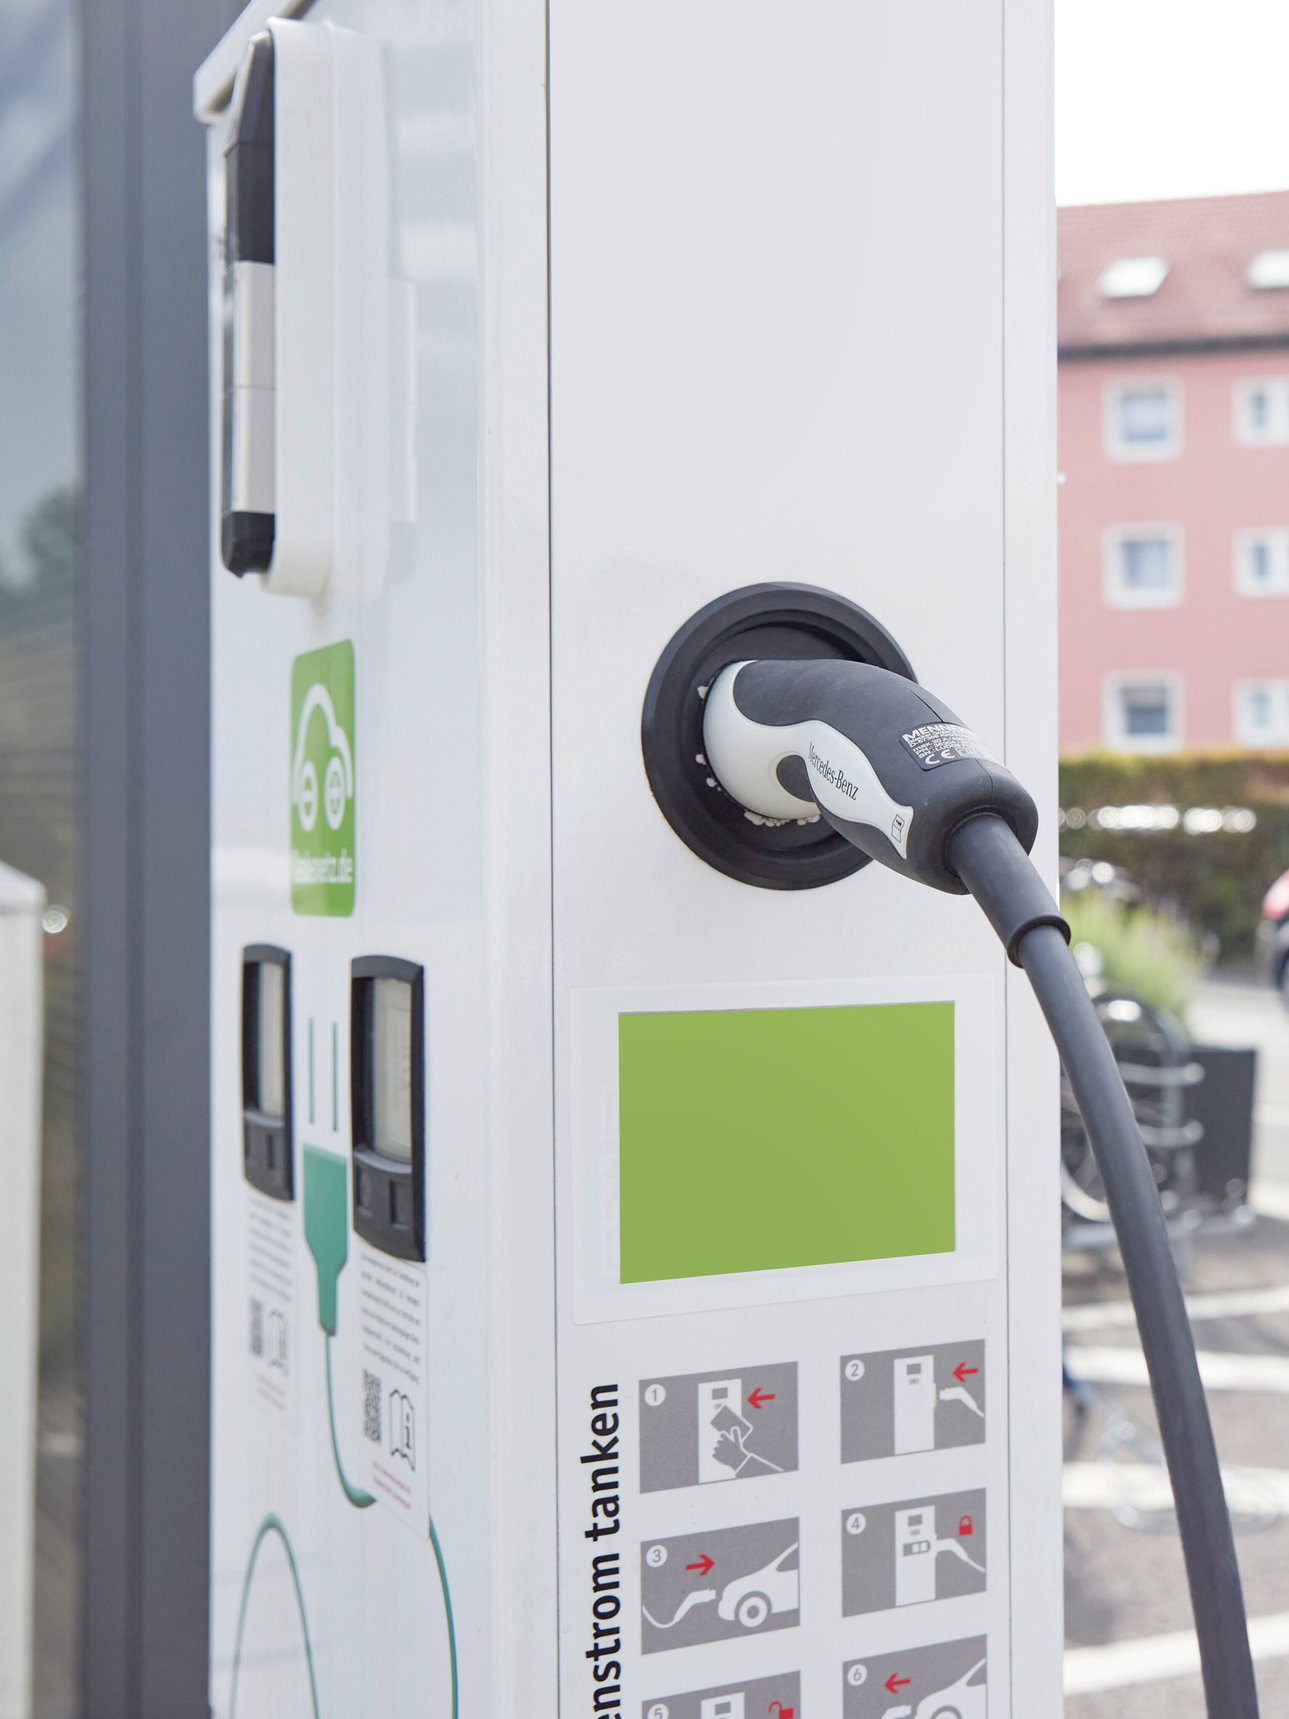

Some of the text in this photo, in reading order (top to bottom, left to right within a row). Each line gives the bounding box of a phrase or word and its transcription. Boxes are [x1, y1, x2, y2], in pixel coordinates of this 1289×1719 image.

[808, 741, 859, 801] Mercedes-Benz
[851, 1363, 859, 1377] 2
[580, 1384, 621, 1542] tanken
[851, 1516, 861, 1530] 4
[652, 1549, 661, 1563] 3
[853, 1668, 861, 1682] 6
